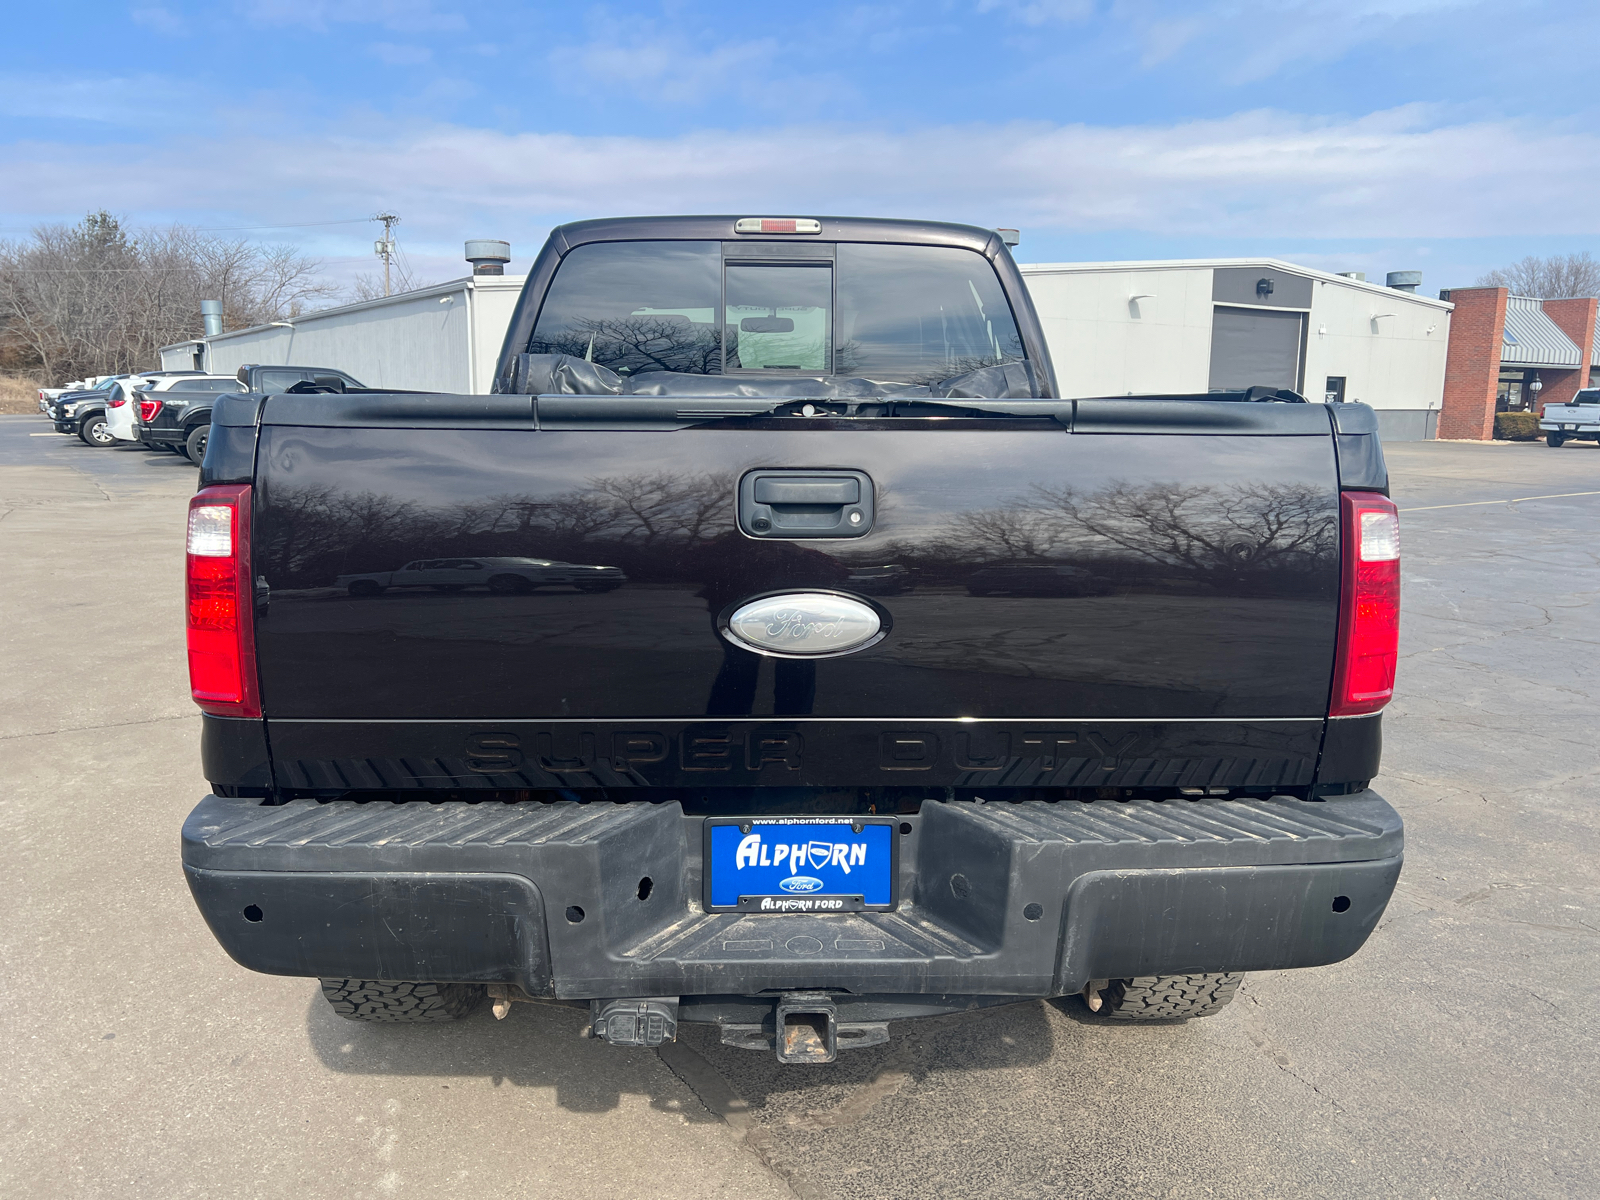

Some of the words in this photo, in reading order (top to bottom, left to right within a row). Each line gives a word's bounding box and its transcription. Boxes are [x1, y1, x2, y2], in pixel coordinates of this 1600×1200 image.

[765, 608, 845, 638] Ford
[463, 731, 805, 773] SUPER
[878, 731, 1141, 771] DUTY
[752, 817, 854, 826] www.alphornford.net
[736, 834, 867, 875] ALPHORN
[788, 879, 815, 890] Ford
[814, 900, 844, 910] FORD
